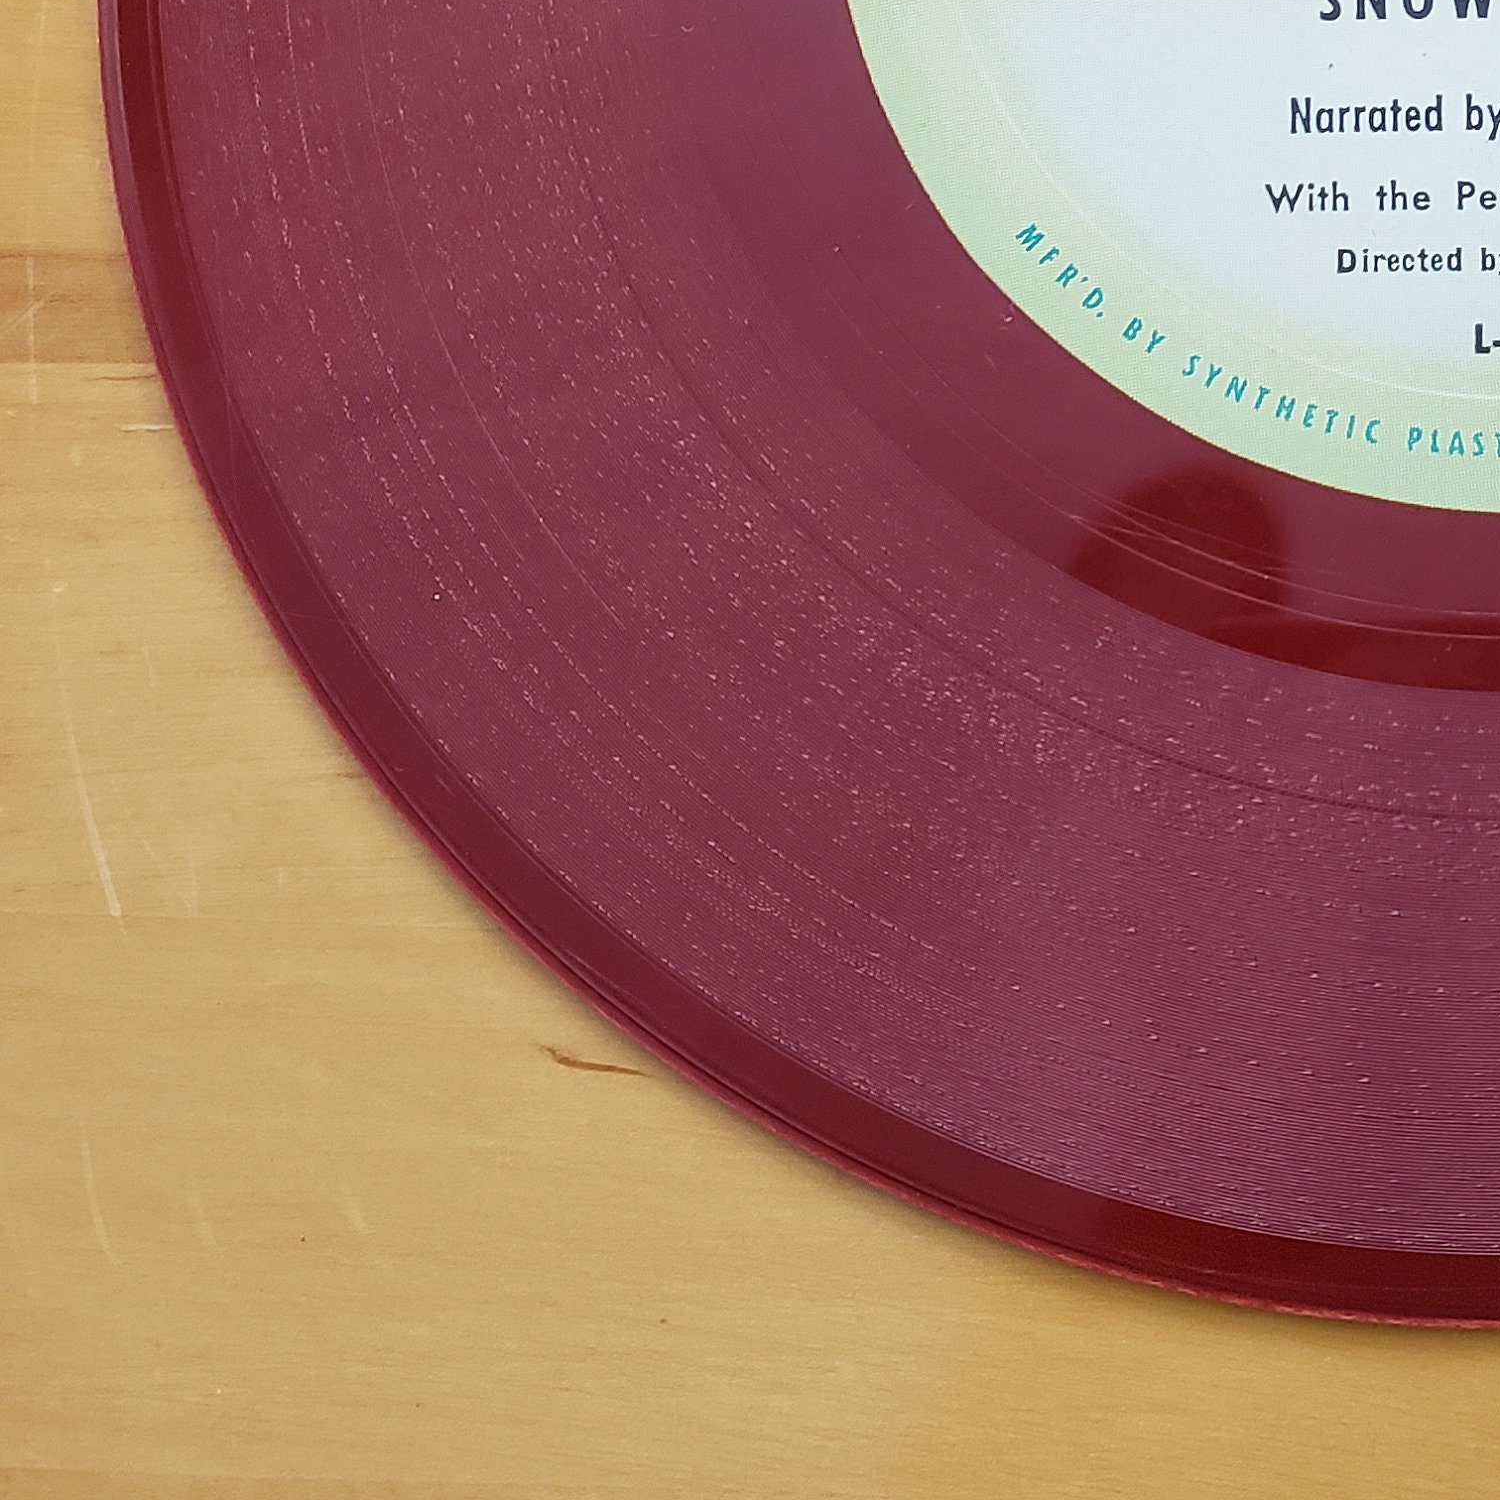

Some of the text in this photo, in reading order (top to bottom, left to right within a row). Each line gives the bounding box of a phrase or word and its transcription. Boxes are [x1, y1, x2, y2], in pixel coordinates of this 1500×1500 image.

[1290, 95, 1443, 135] Narrated
[1265, 181, 1349, 214] With
[1376, 180, 1431, 211] the
[1337, 248, 1462, 274] Directed
[1014, 223, 1105, 318] MFR'D.
[1122, 316, 1166, 355] BY
[1181, 354, 1382, 445] SYNTHETIC
